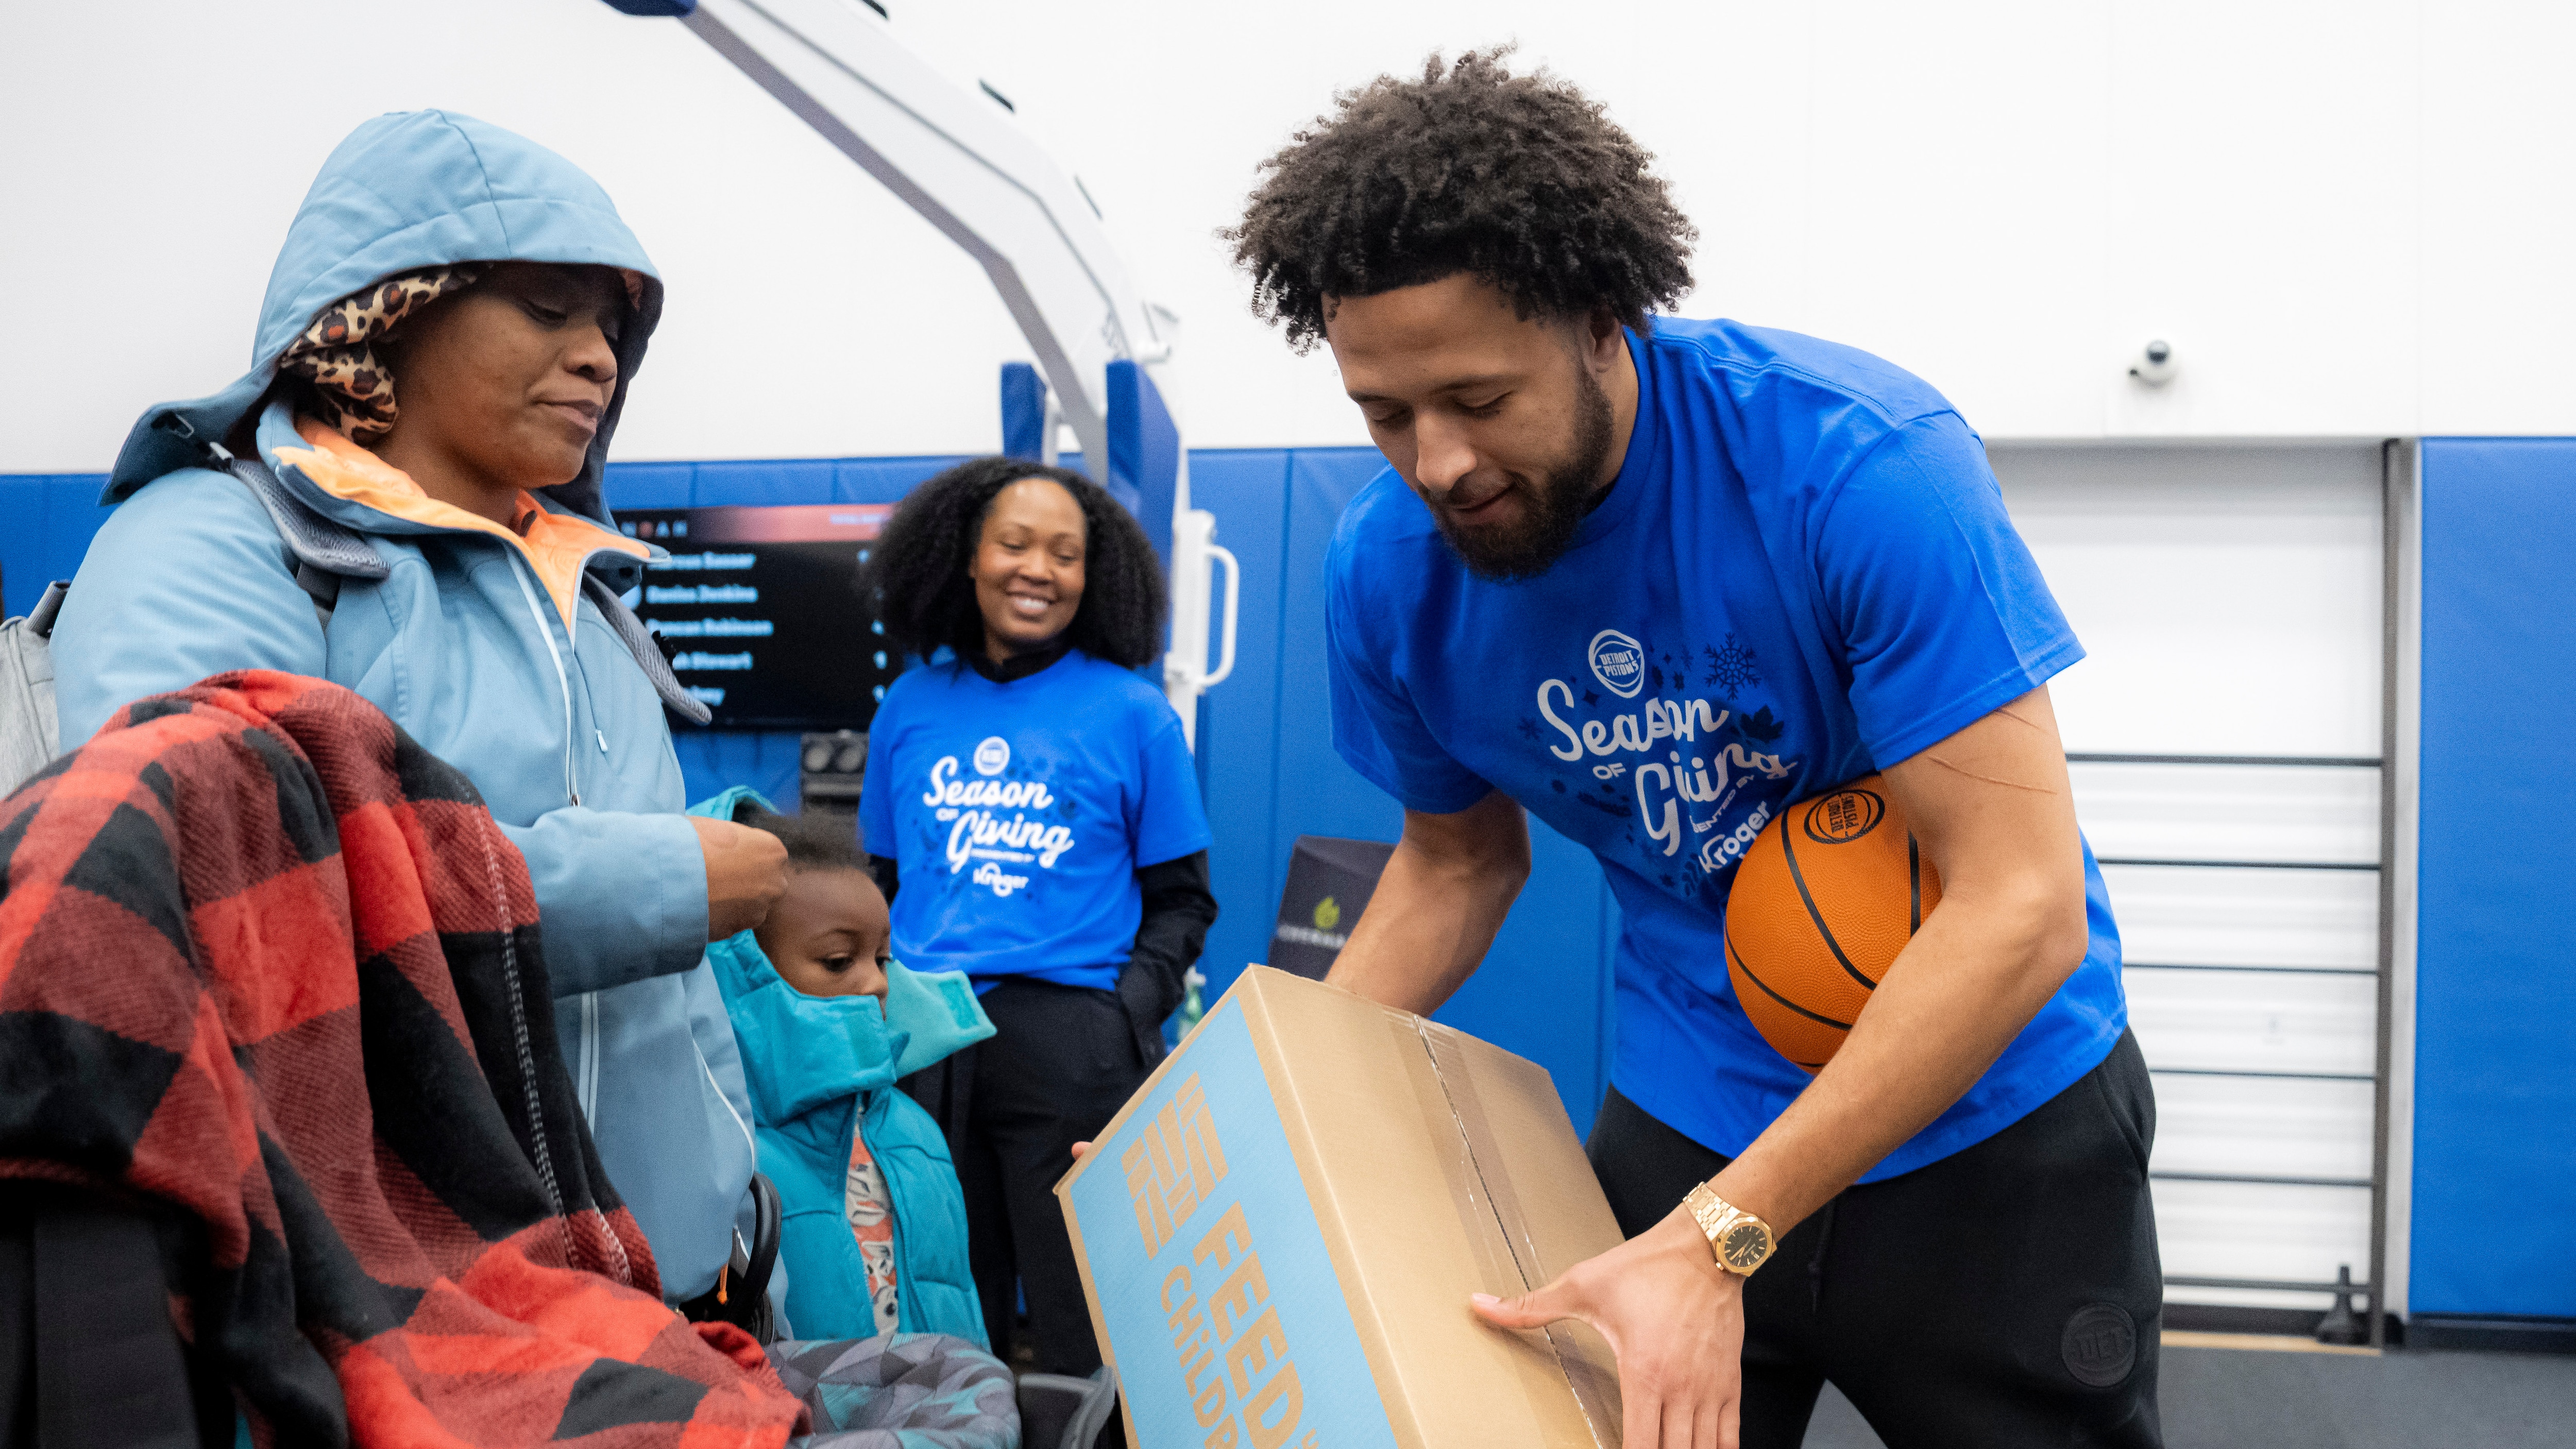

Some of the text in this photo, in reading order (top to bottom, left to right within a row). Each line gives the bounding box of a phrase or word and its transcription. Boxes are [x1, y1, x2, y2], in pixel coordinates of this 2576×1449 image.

[1599, 650, 1634, 665] DETROIT
[1603, 660, 1639, 676] PISTONS
[1538, 679, 1729, 762] Season
[923, 756, 1054, 809] Season
[1592, 762, 1626, 780] OF
[947, 810, 1075, 874] Giving
[1192, 1200, 1303, 1449] FEED
